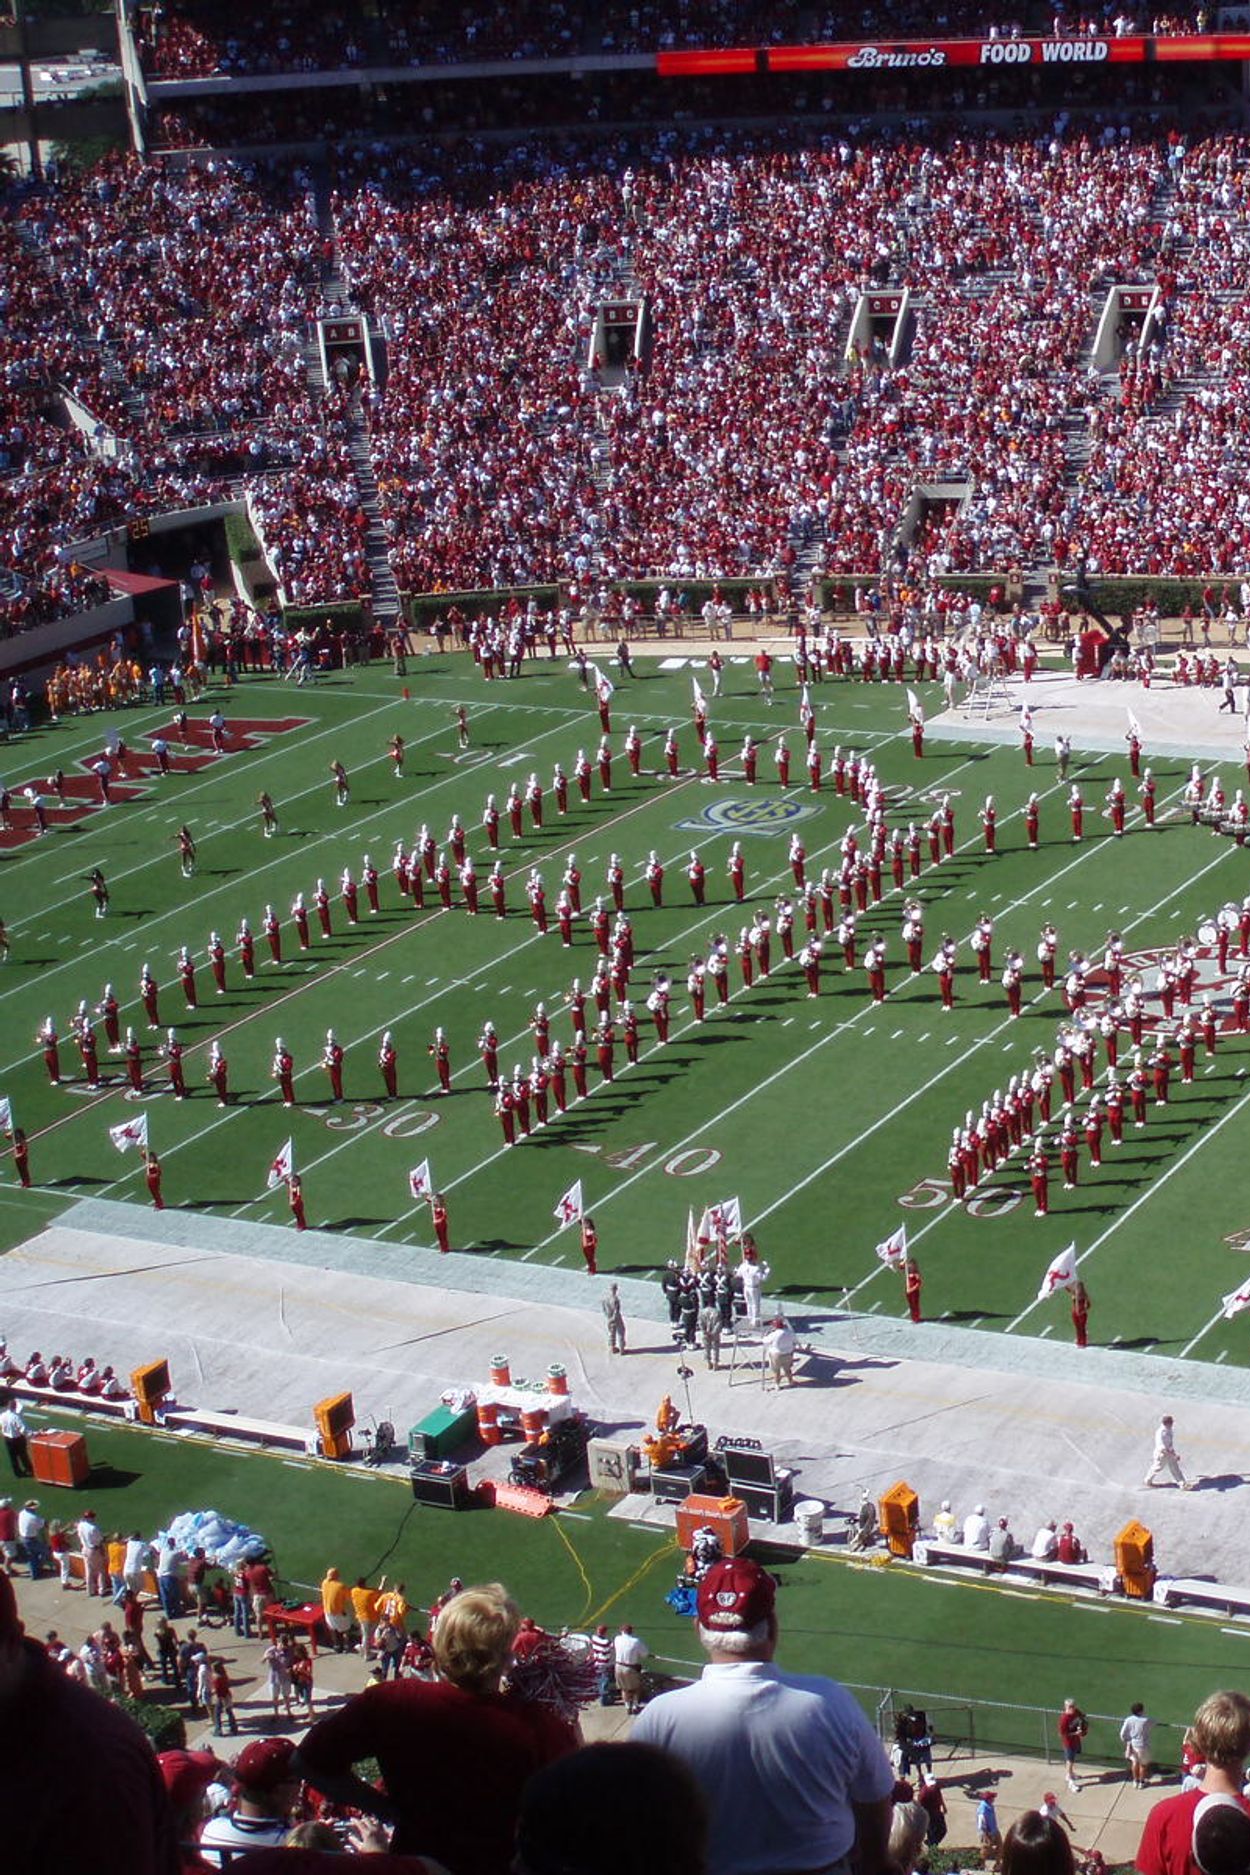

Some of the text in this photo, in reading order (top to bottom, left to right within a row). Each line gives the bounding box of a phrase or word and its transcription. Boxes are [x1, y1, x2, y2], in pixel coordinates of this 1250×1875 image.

[847, 41, 1108, 68] Bruno's FOOD WORLD
[323, 1104, 441, 1138] 30
[603, 1140, 723, 1177] 40
[898, 1177, 1024, 1217] 50
